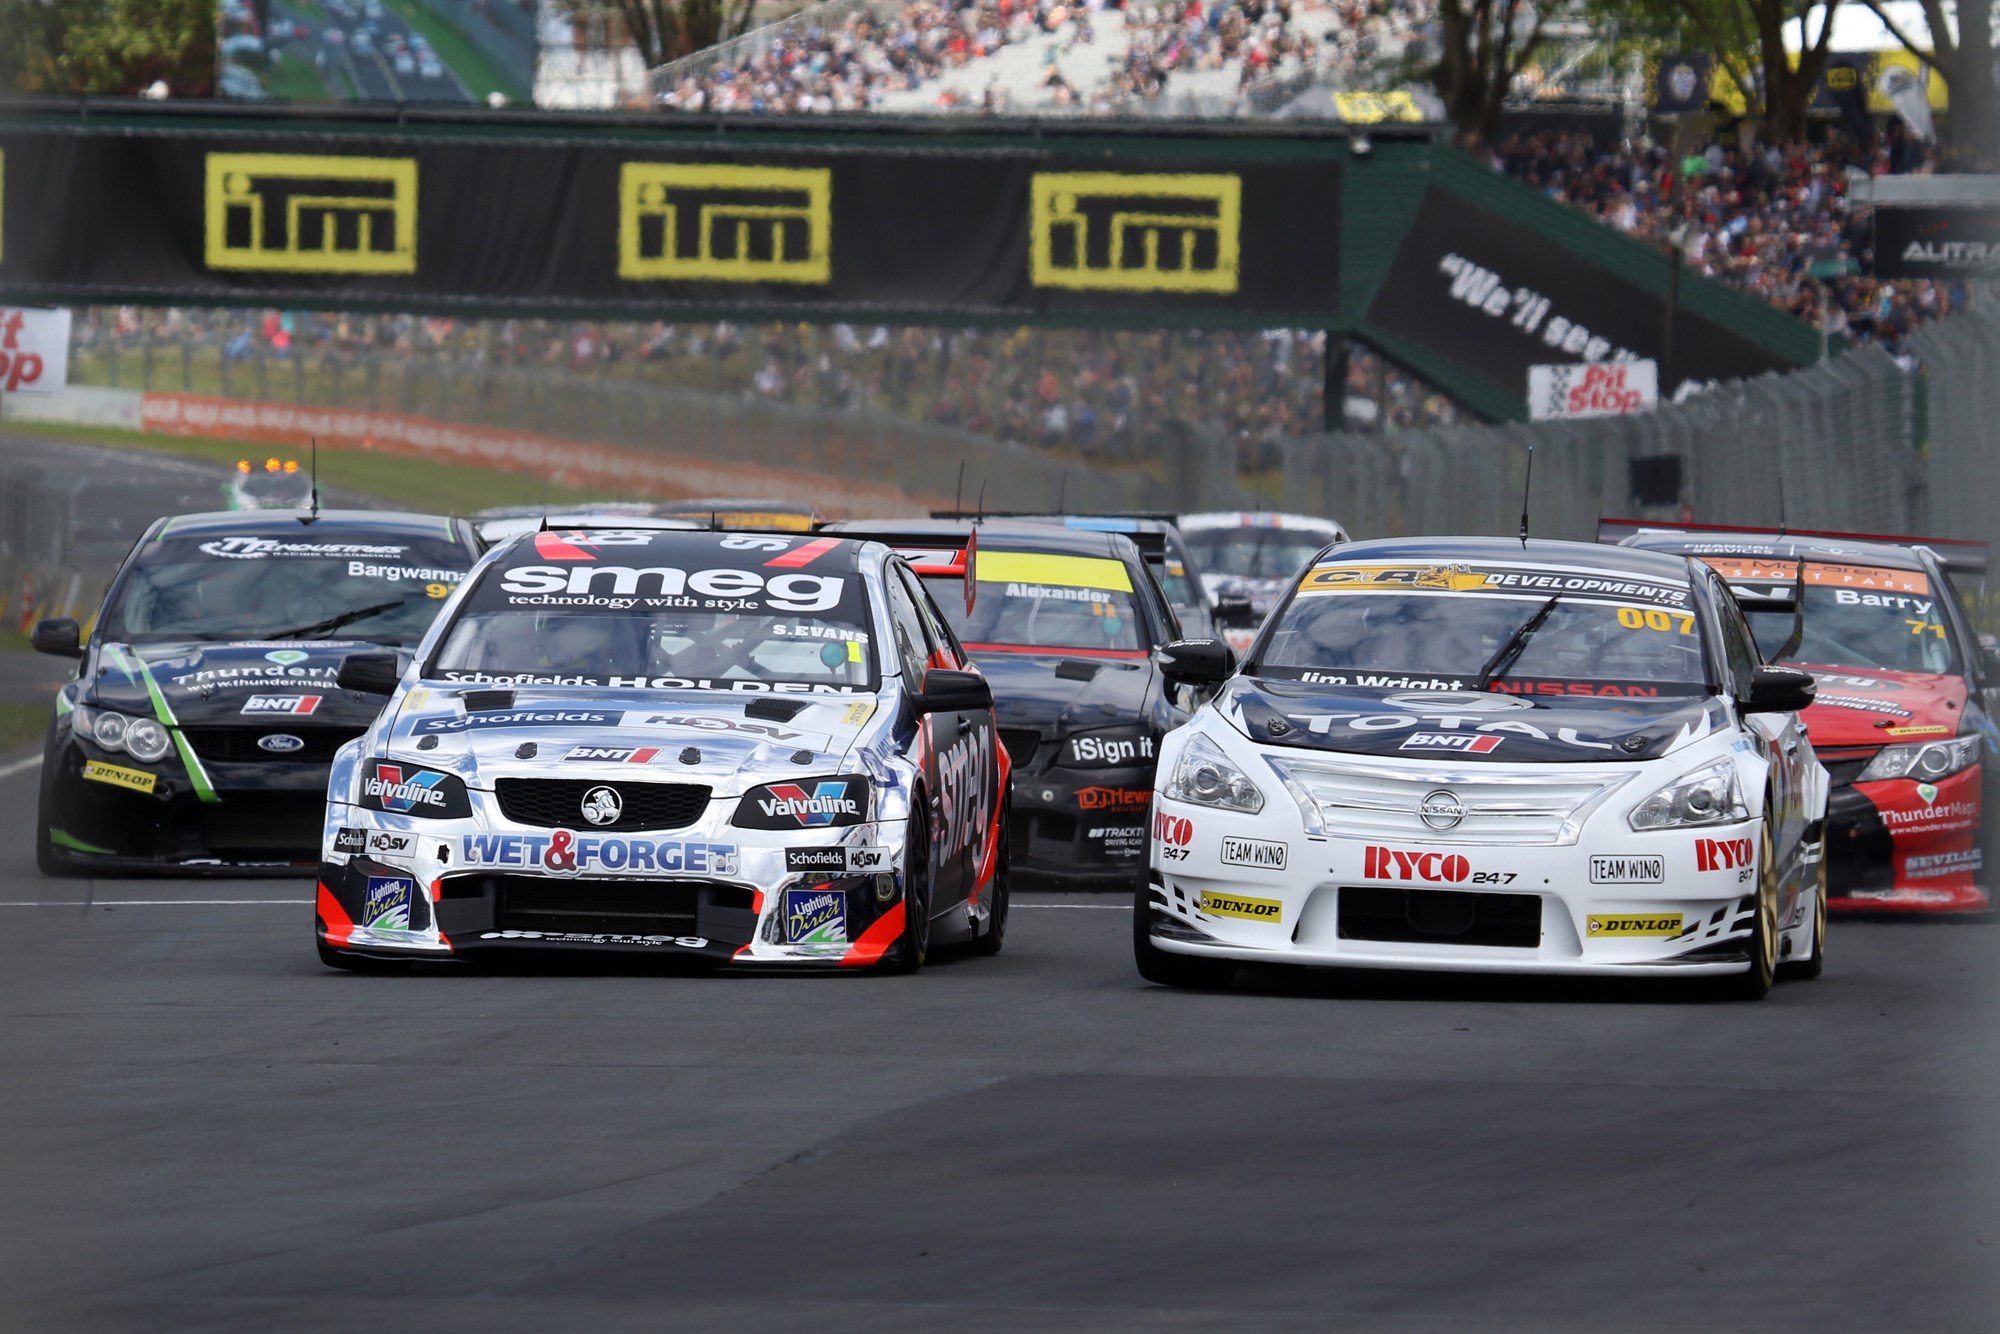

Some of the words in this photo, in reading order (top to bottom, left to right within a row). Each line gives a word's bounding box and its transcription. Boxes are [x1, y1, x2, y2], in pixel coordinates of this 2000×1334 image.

[1584, 366, 1628, 392] Pit
[1568, 388, 1642, 416] Stop
[500, 564, 844, 612] smeg
[1005, 582, 1111, 604] Alexander
[1485, 573, 1688, 601] DEVELOPMENTS
[1843, 575, 1914, 592] PARK
[508, 594, 640, 609] technology
[645, 595, 699, 608] with
[704, 598, 759, 612] style
[1835, 589, 1932, 615] Barry
[1617, 607, 1696, 635] 007
[1905, 619, 1946, 640] 71
[772, 623, 870, 645] S.EVANS
[444, 671, 598, 688] Schofields
[608, 676, 854, 695] HOLDEN
[1489, 681, 1658, 698] NISSAN
[247, 697, 299, 711] BNT
[426, 711, 606, 731] Schofields
[1287, 713, 1613, 750] TOTAL
[1072, 736, 1135, 763] iSign
[1139, 736, 1154, 758] it
[1408, 734, 1470, 747] BNT
[573, 747, 631, 759] BNT
[94, 766, 153, 787] DUNLOP
[364, 777, 446, 807] Valvoline
[938, 724, 991, 878] smeg
[757, 795, 857, 817] Valvoline
[1421, 806, 1462, 815] NISSAN
[789, 851, 844, 866] Schofields
[1225, 841, 1252, 862] TEAM
[1694, 837, 1753, 872] RYCO
[1364, 845, 1470, 883] RYCO
[1593, 859, 1625, 880] TEAM
[371, 880, 400, 903] Lighting
[365, 885, 407, 925] Direct
[794, 893, 833, 916] Lighting
[1211, 898, 1280, 916] DUNLOP
[789, 897, 840, 940] Direct
[1604, 918, 1681, 932] DUNLOP
